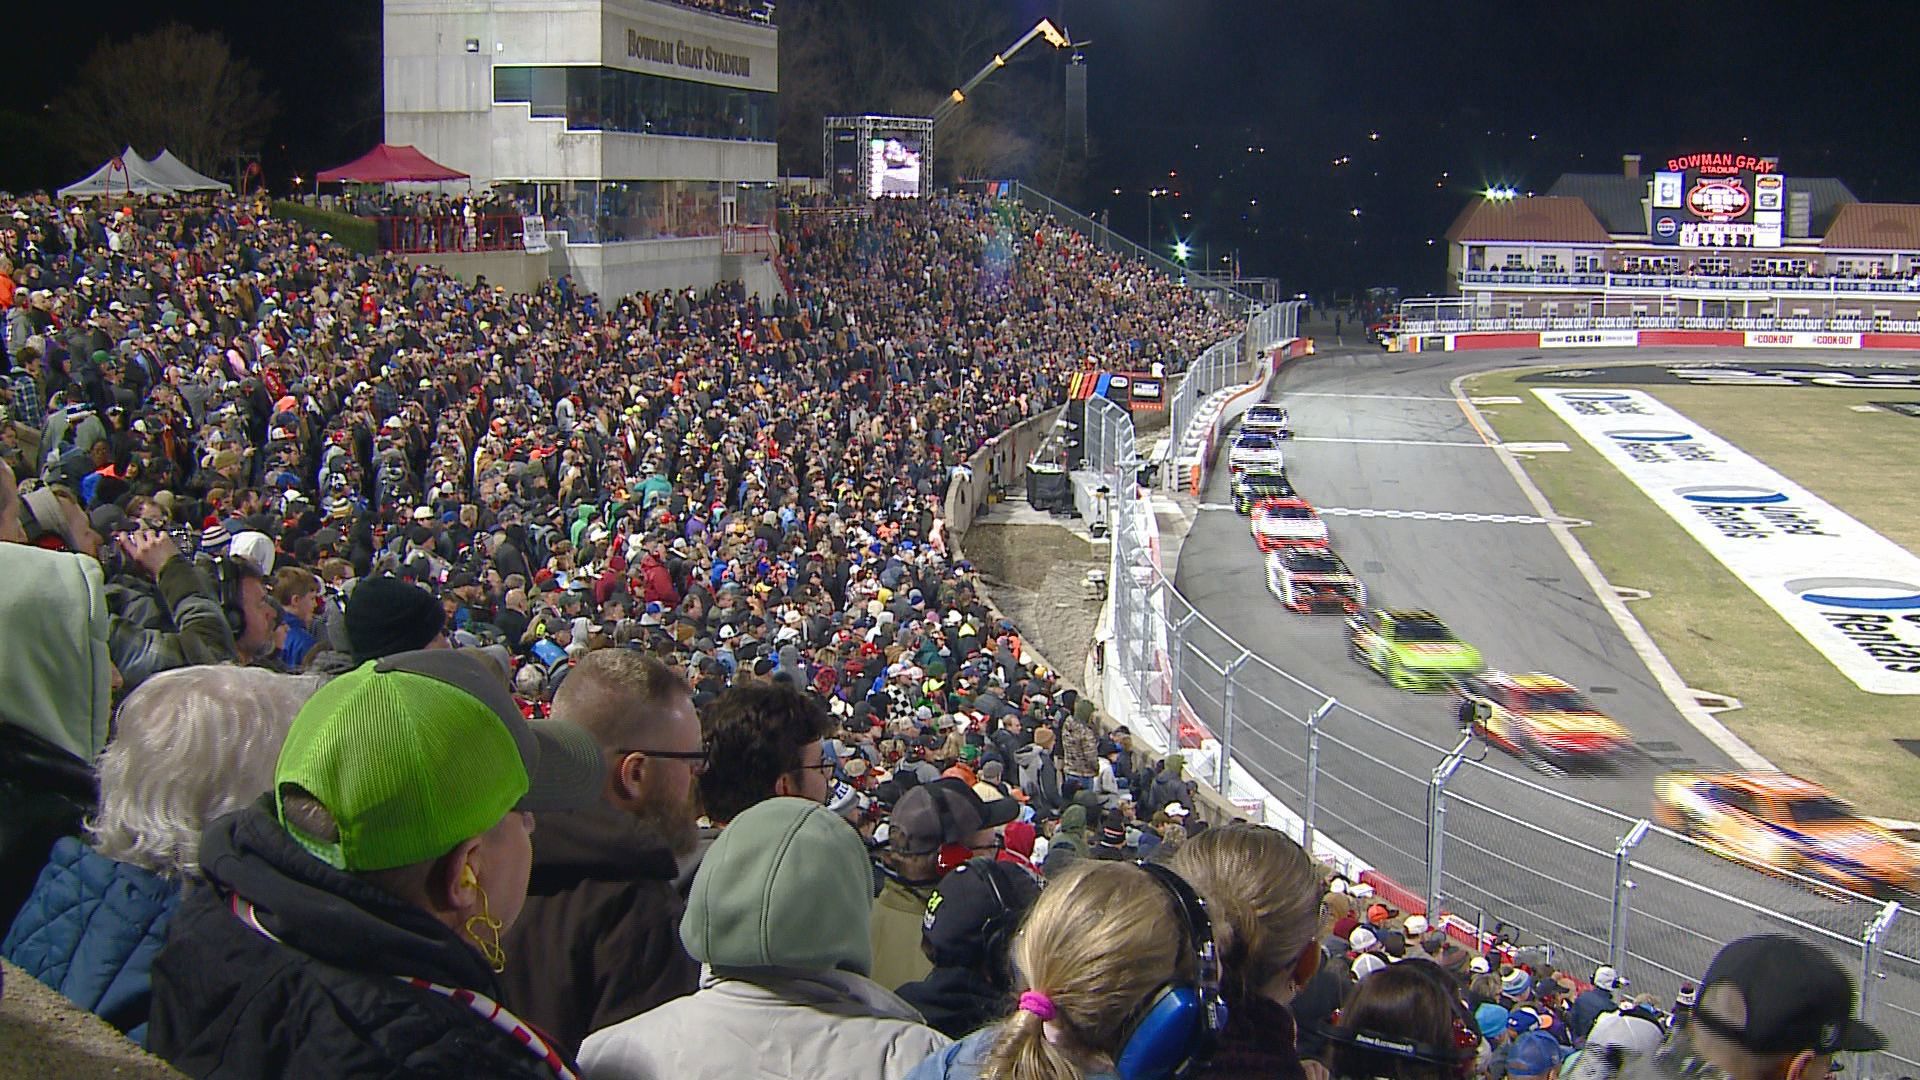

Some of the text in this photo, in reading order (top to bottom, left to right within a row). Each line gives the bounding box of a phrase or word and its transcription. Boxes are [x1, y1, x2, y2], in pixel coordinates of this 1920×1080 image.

[628, 29, 750, 77] BOWMAN GRAY STADIUM
[1668, 154, 1775, 174] BOWMAN GRAY
[1700, 166, 1739, 174] STADIUM
[1423, 321, 1434, 332] OUT
[1441, 320, 1470, 332] COOK OUT
[1476, 319, 1507, 331] COOK OUT
[1514, 318, 1546, 330] COOK OUT
[1554, 318, 1588, 329] COOK OUT
[1595, 317, 1630, 329] COOK OUT
[1638, 317, 1676, 329] COOK OUT
[1684, 317, 1724, 329] COOK OUT
[1732, 318, 1772, 330] COOK OUT
[1782, 318, 1822, 330] COOK OUT
[1831, 319, 1871, 330] COOK OUT
[1881, 320, 1904, 332] COOK
[1565, 335, 1601, 343] CLASH
[1757, 335, 1793, 344] COOK OUT
[1817, 336, 1853, 344] COOK OUT
